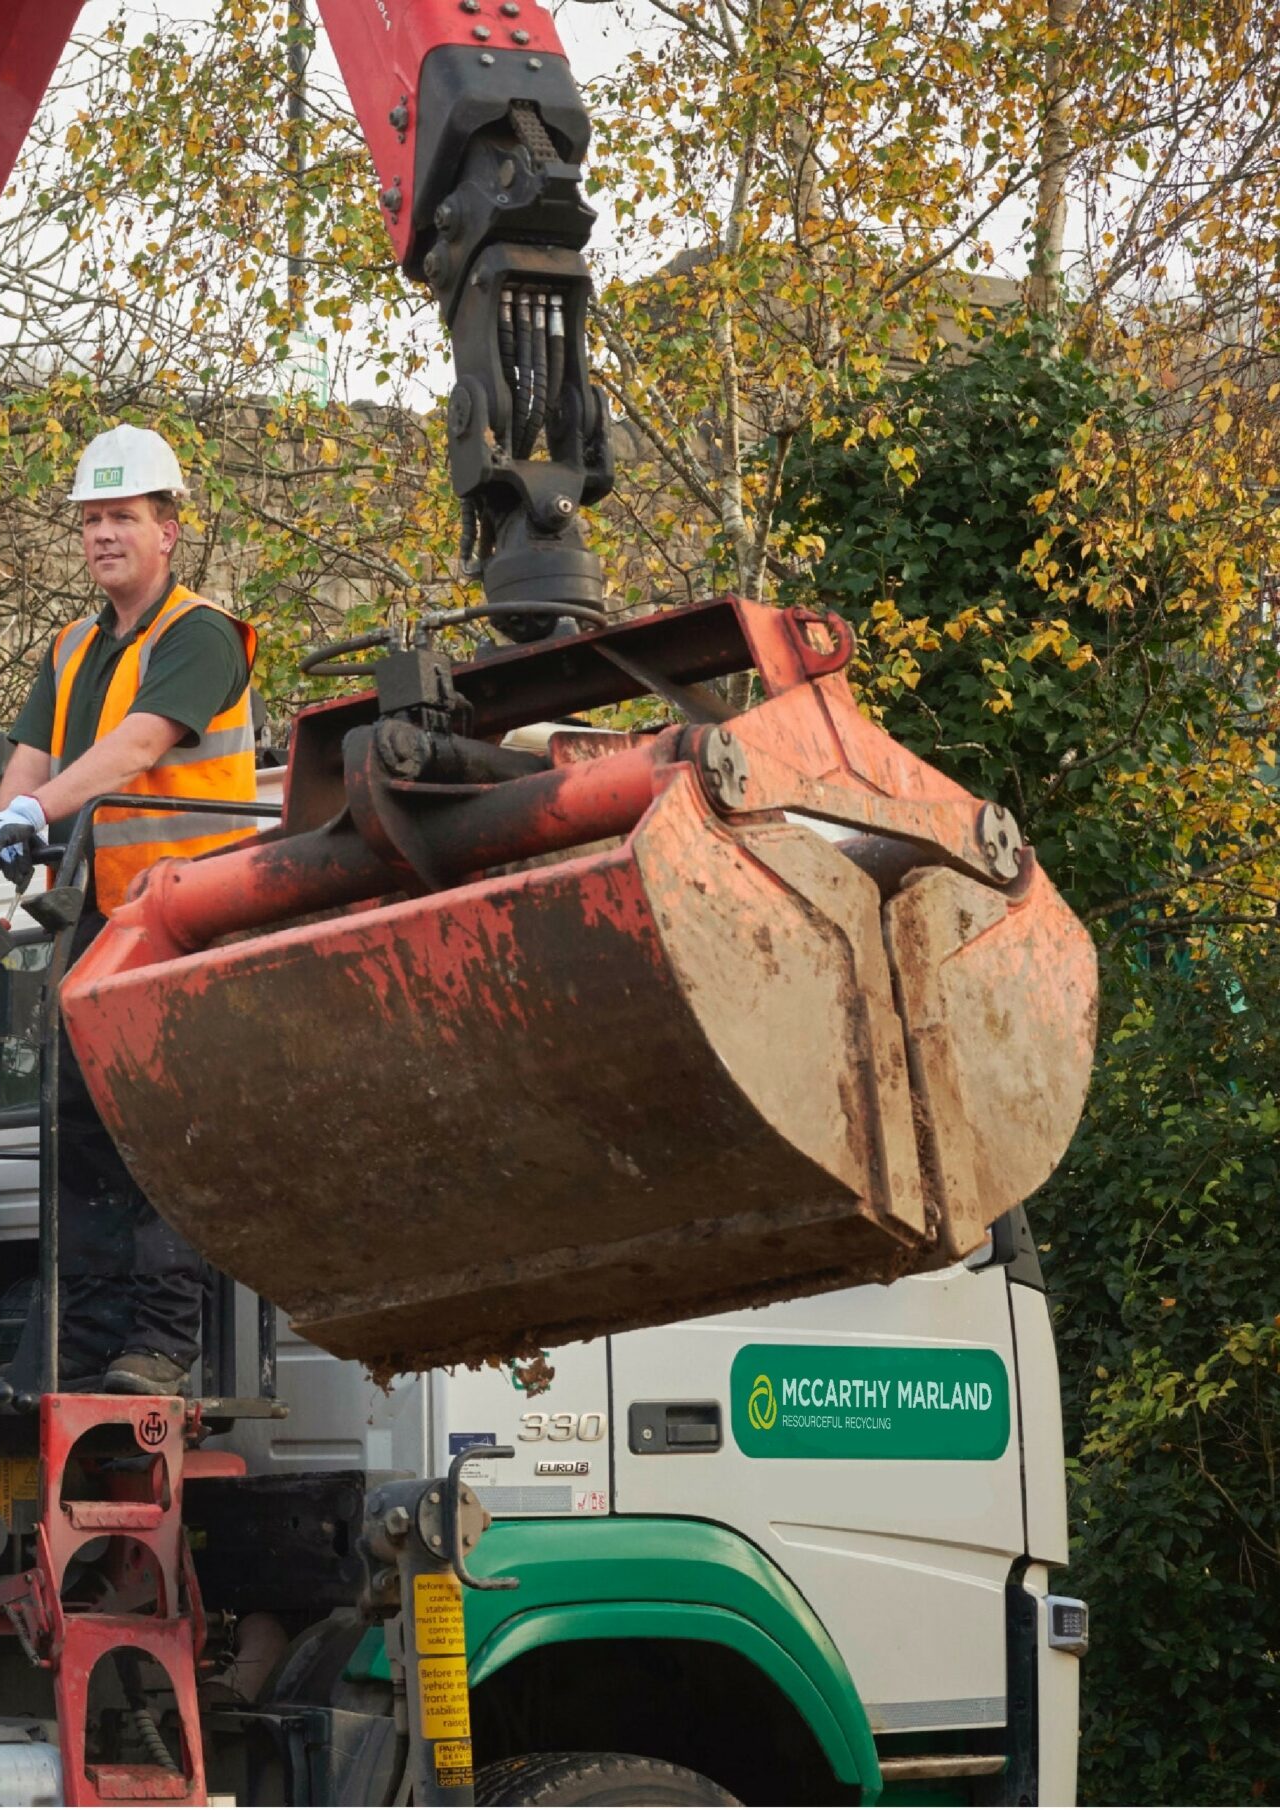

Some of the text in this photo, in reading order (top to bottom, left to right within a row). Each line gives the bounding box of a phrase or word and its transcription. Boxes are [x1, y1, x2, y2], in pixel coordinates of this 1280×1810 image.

[782, 1378, 993, 1411] MCCARTHY MARLAND
[517, 1412, 607, 1442] 330
[782, 1415, 892, 1430] RESOURCEFUL RECYCLING
[416, 1616, 437, 1624] must
[439, 1616, 449, 1624] be
[421, 1668, 452, 1678] Before
[424, 1681, 455, 1691] vehicle
[423, 1694, 448, 1703] front
